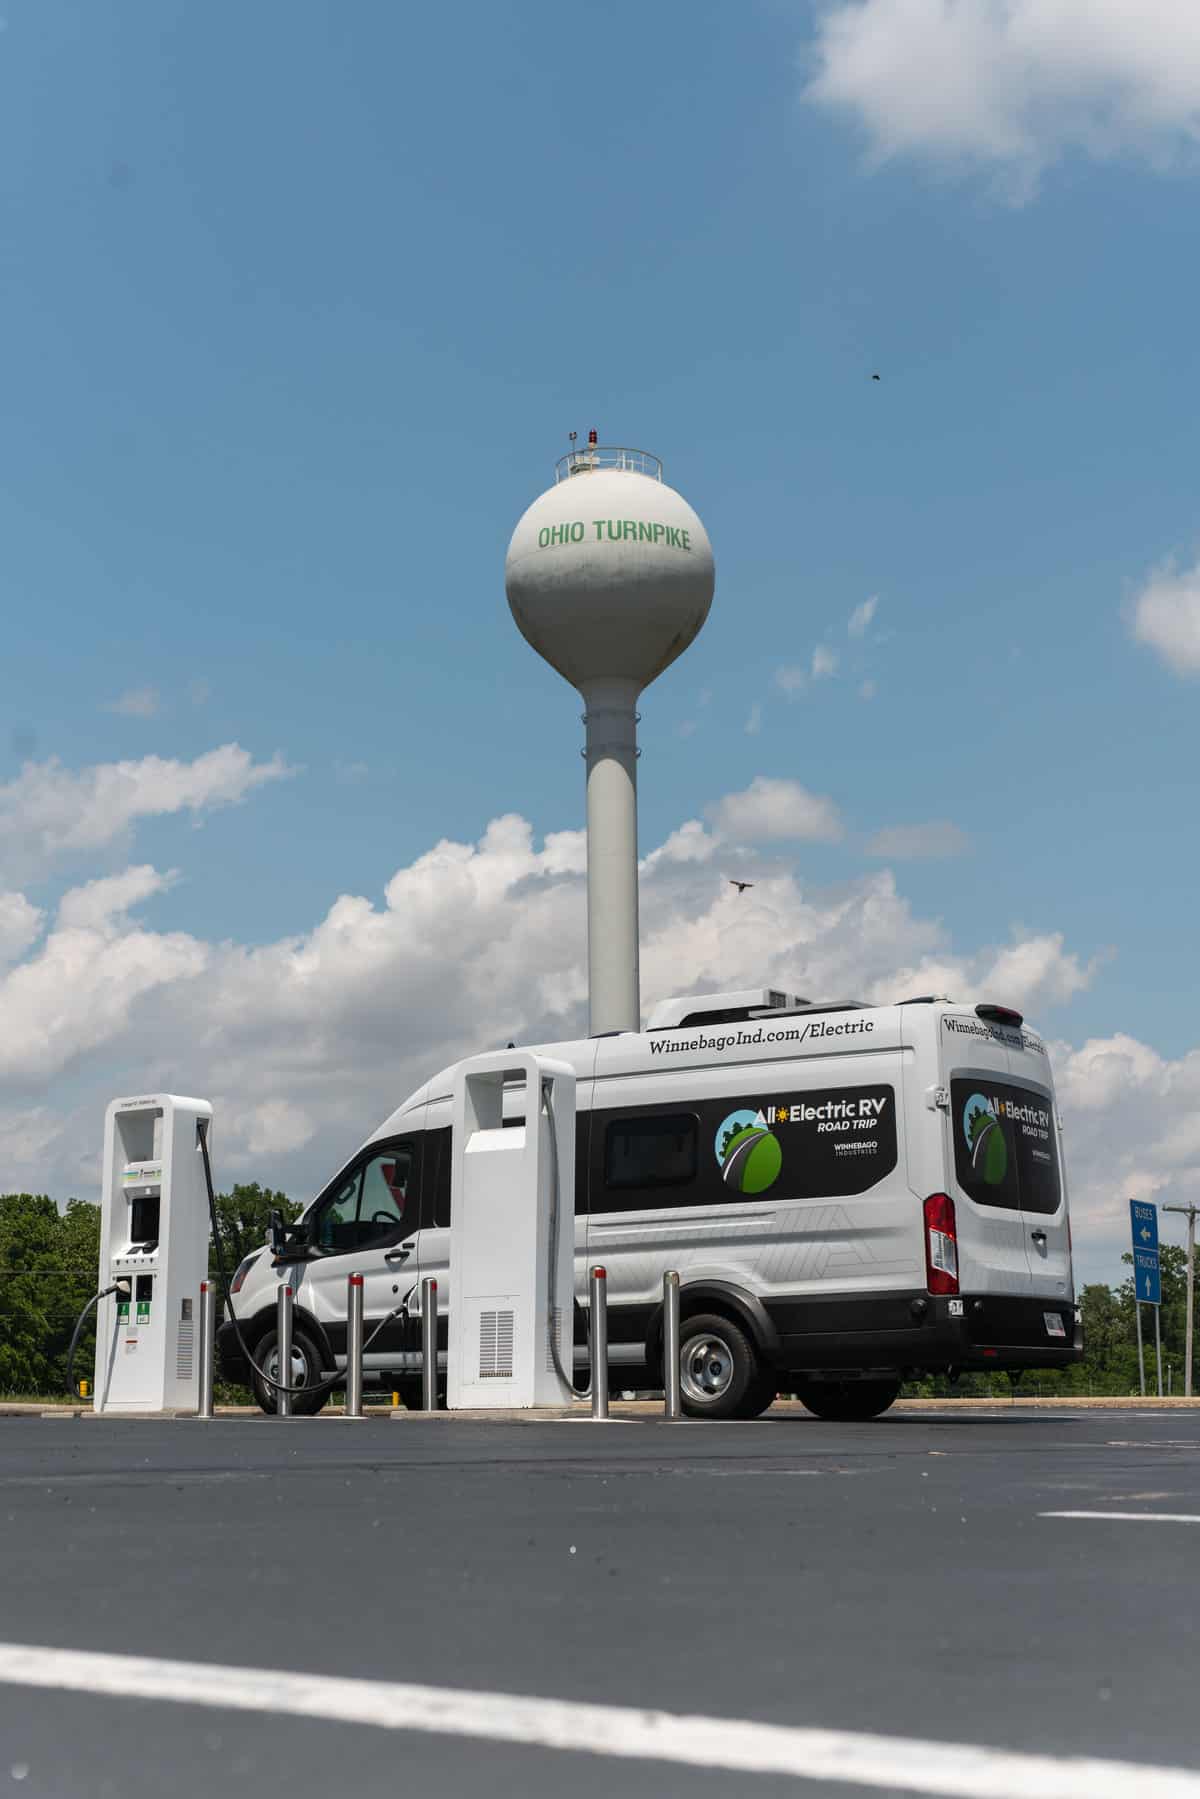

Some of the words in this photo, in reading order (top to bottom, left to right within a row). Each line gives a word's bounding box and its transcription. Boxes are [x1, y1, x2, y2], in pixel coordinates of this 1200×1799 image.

[538, 521, 585, 549] OHIO
[592, 519, 692, 551] TURNPIKE
[649, 1019, 875, 1055] WinnebagoInd.com/Electric
[789, 1099, 855, 1122] Electric
[858, 1097, 887, 1117] RV
[1005, 1100, 1039, 1124] Electric
[1038, 1110, 1049, 1128] RV
[817, 1120, 850, 1133] ROAD
[852, 1118, 878, 1130] TRIP
[1022, 1125, 1038, 1137] ROAD
[833, 1141, 878, 1151] WINNEBAGO
[834, 1148, 878, 1157] INDUSTRIES
[1134, 1206, 1153, 1220] BUSES
[1136, 1254, 1158, 1269] TRUCKS
